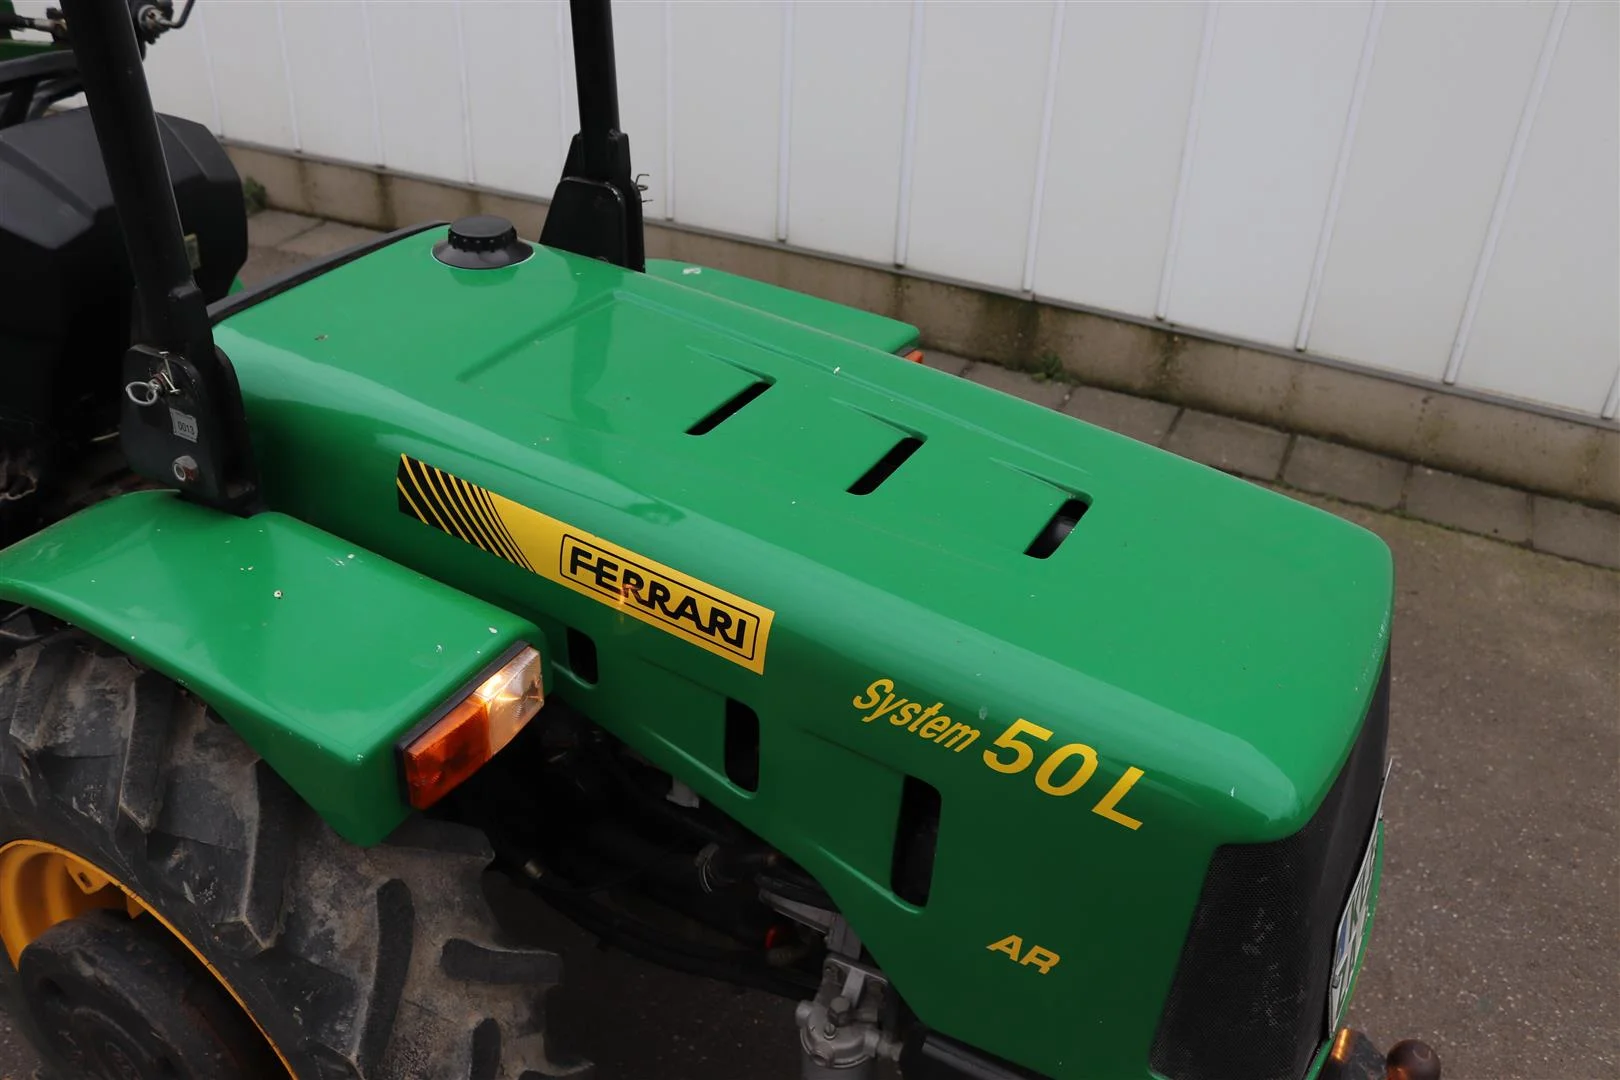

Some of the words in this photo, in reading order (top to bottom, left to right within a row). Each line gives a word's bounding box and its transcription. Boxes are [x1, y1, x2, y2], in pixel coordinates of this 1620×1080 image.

[570, 545, 747, 649] FERRARI
[852, 678, 981, 753] System
[986, 934, 1060, 975] AR
